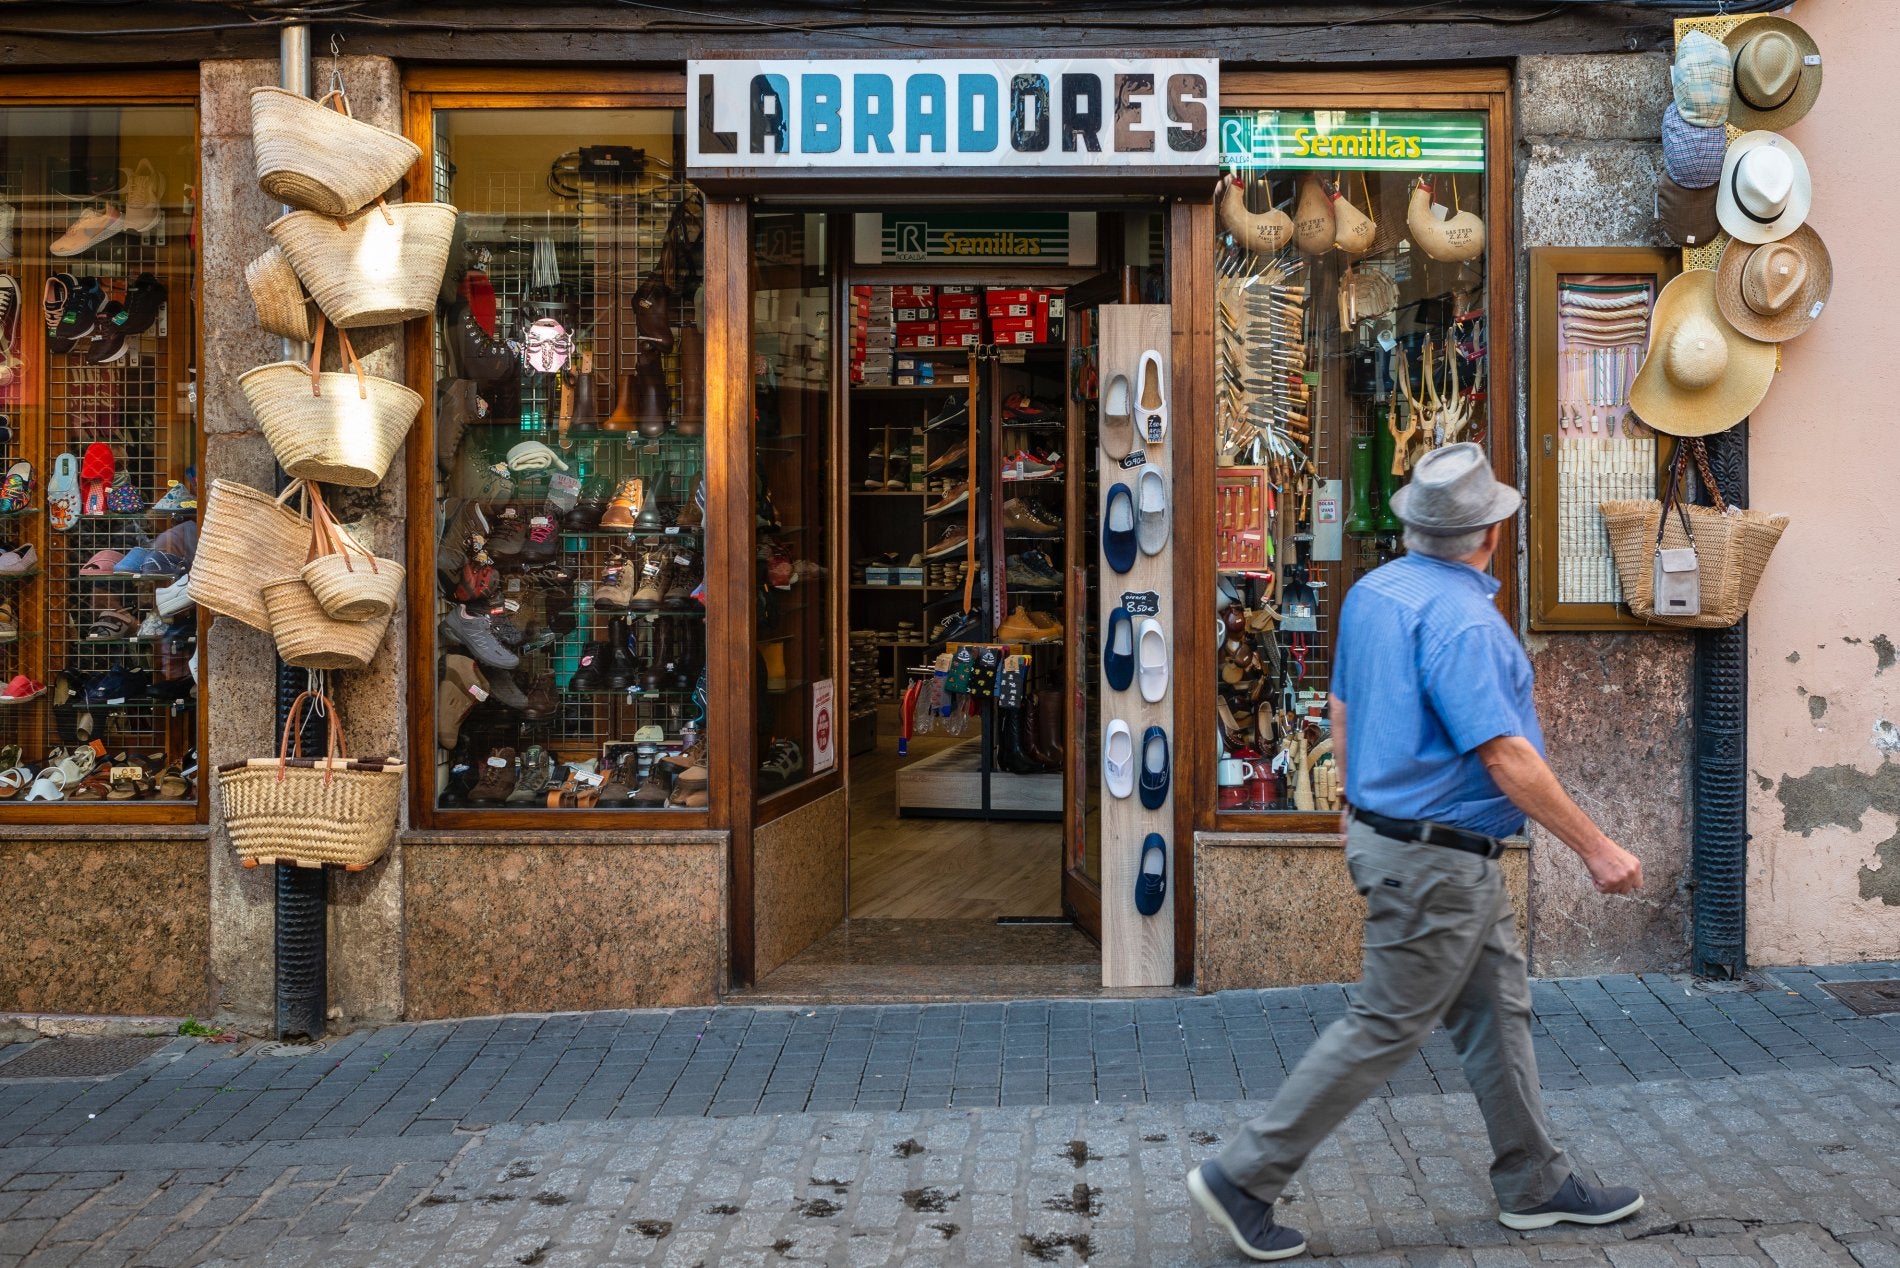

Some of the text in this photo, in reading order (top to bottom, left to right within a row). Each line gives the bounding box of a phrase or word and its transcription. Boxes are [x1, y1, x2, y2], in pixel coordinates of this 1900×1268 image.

[699, 73, 1208, 153] LABRADORES
[1294, 128, 1422, 158] Semillas
[943, 231, 1041, 255] Semillas
